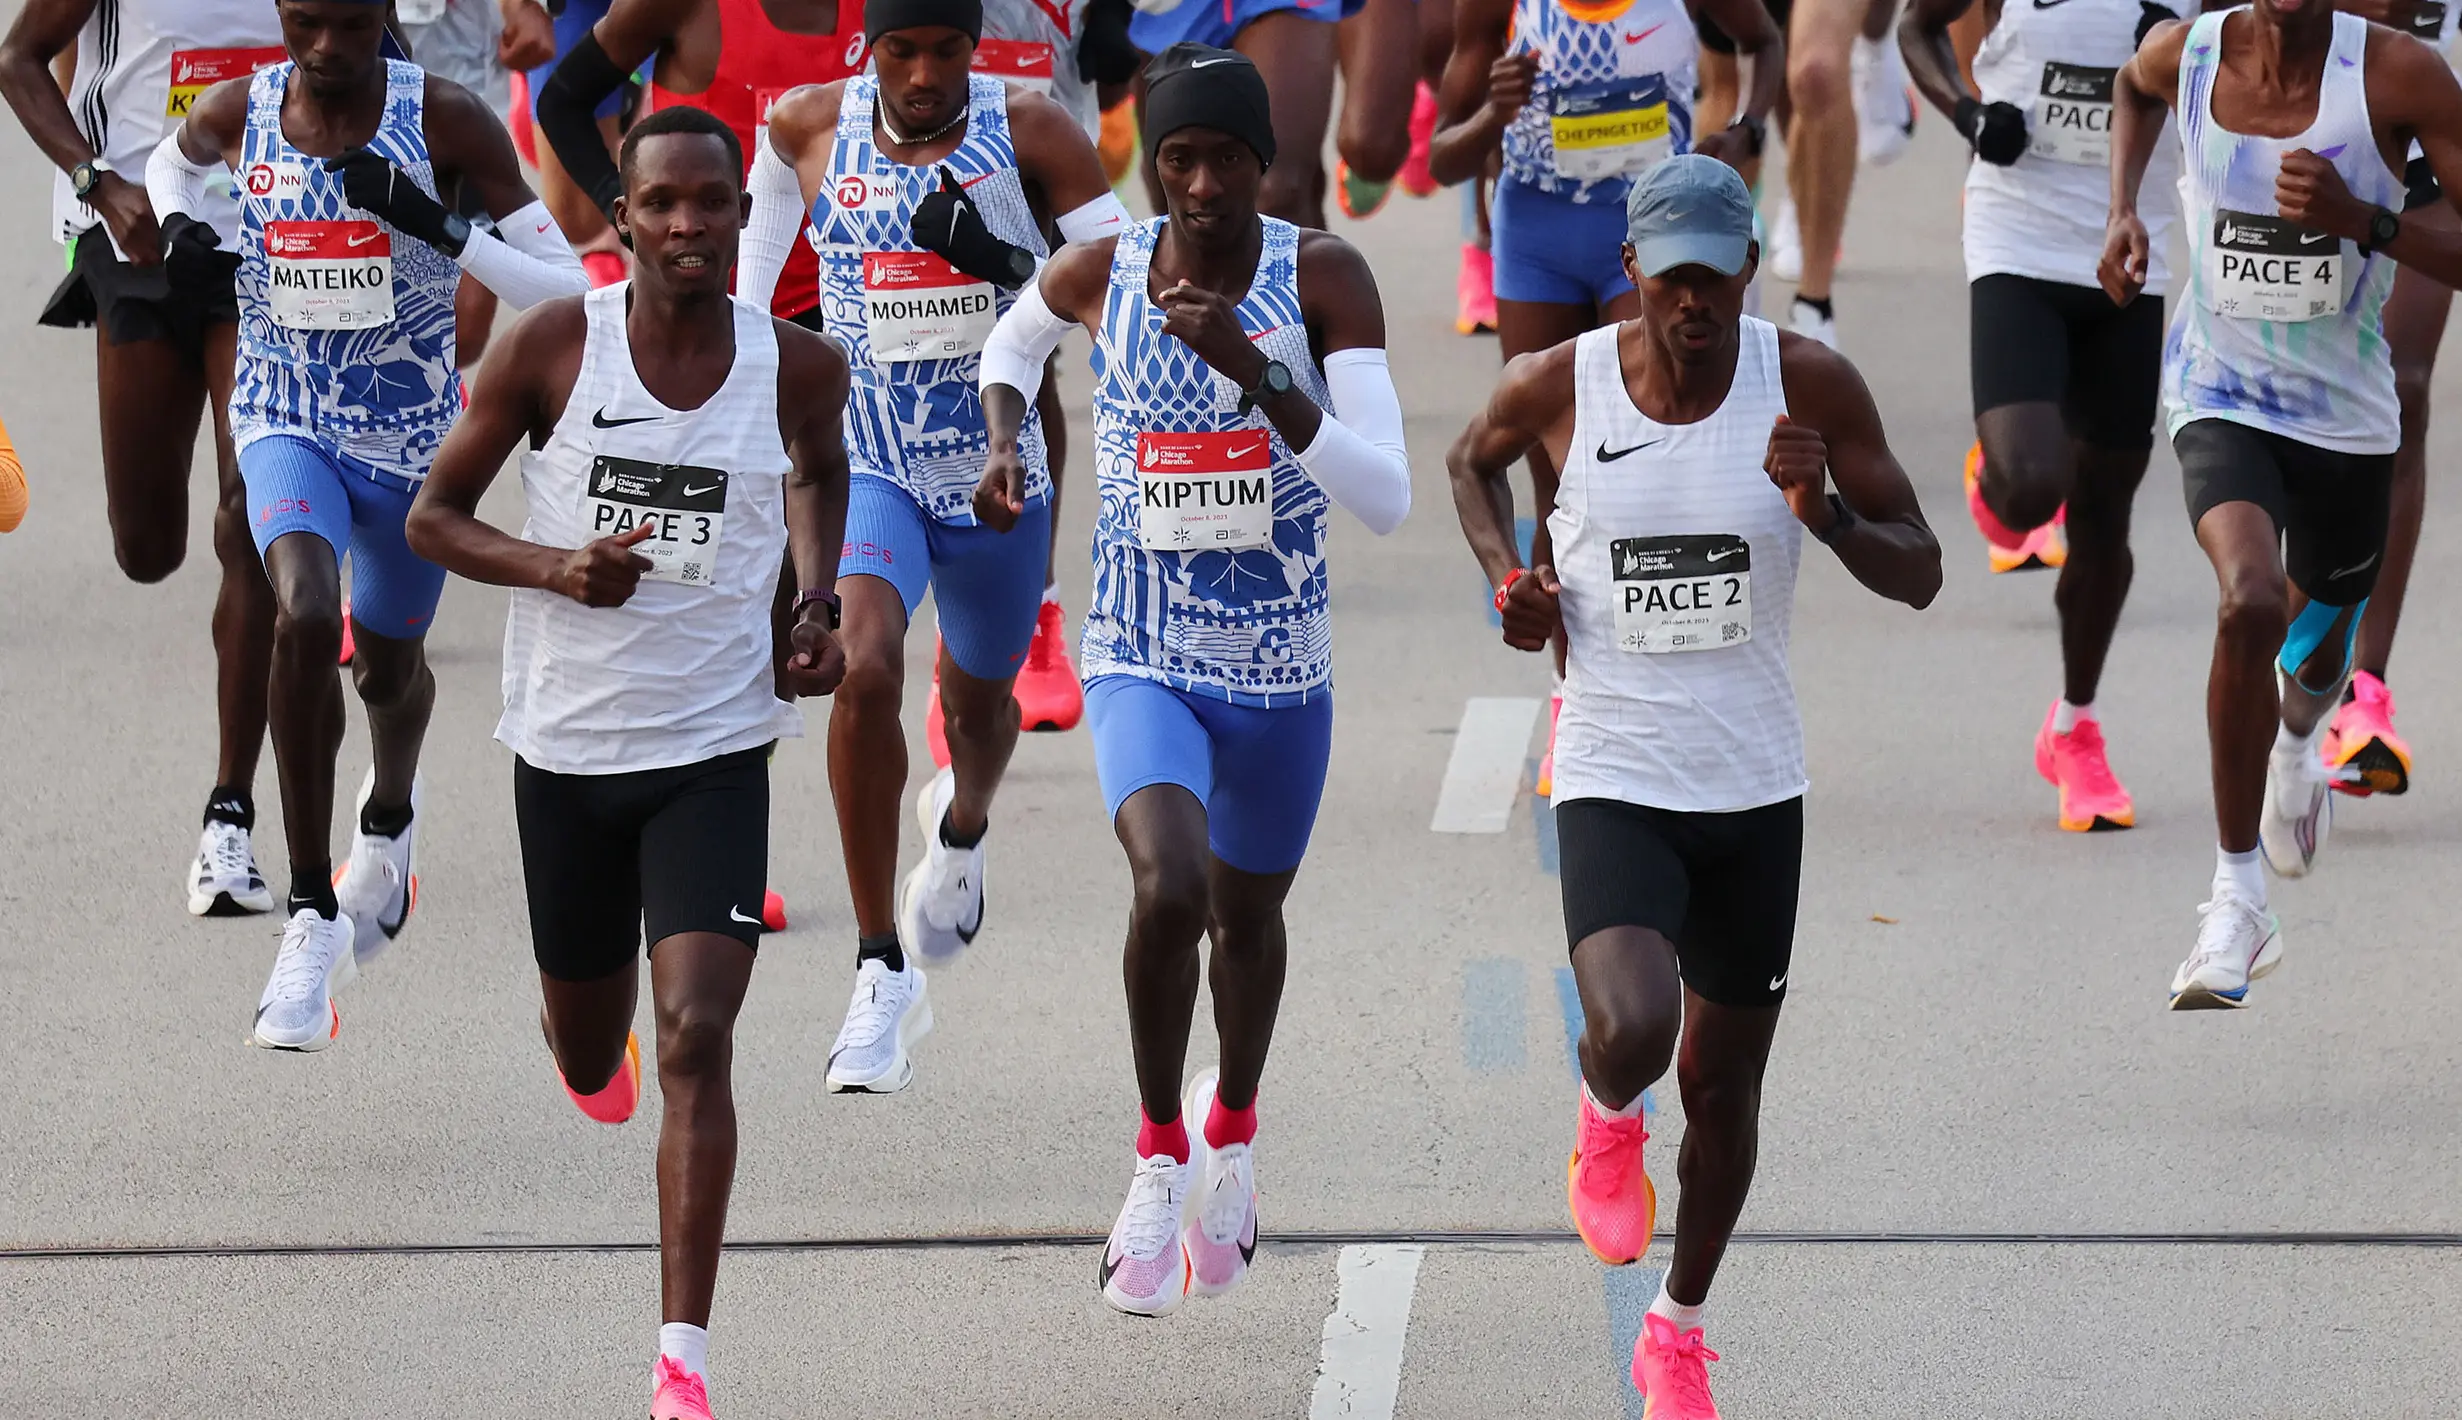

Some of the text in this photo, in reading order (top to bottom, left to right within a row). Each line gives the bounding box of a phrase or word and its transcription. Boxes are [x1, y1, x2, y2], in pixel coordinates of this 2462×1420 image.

[280, 175, 301, 186] NN
[873, 186, 895, 197] NN
[285, 238, 310, 246] Chicago
[886, 268, 912, 277] Chicago
[2222, 254, 2333, 286] PACE 4
[274, 265, 384, 290] MATEIKO
[886, 275, 920, 283] Marathon
[872, 294, 989, 320] MOHAMED
[1160, 451, 1187, 460] Chicago
[617, 478, 645, 490] Chicago
[616, 486, 650, 497] Marathon
[1144, 477, 1265, 508] KIPTUM
[594, 504, 711, 546] PACE 3
[1639, 557, 1667, 565] Chicago
[1640, 563, 1674, 572] Marathon
[1624, 578, 1742, 613] PACE 2
